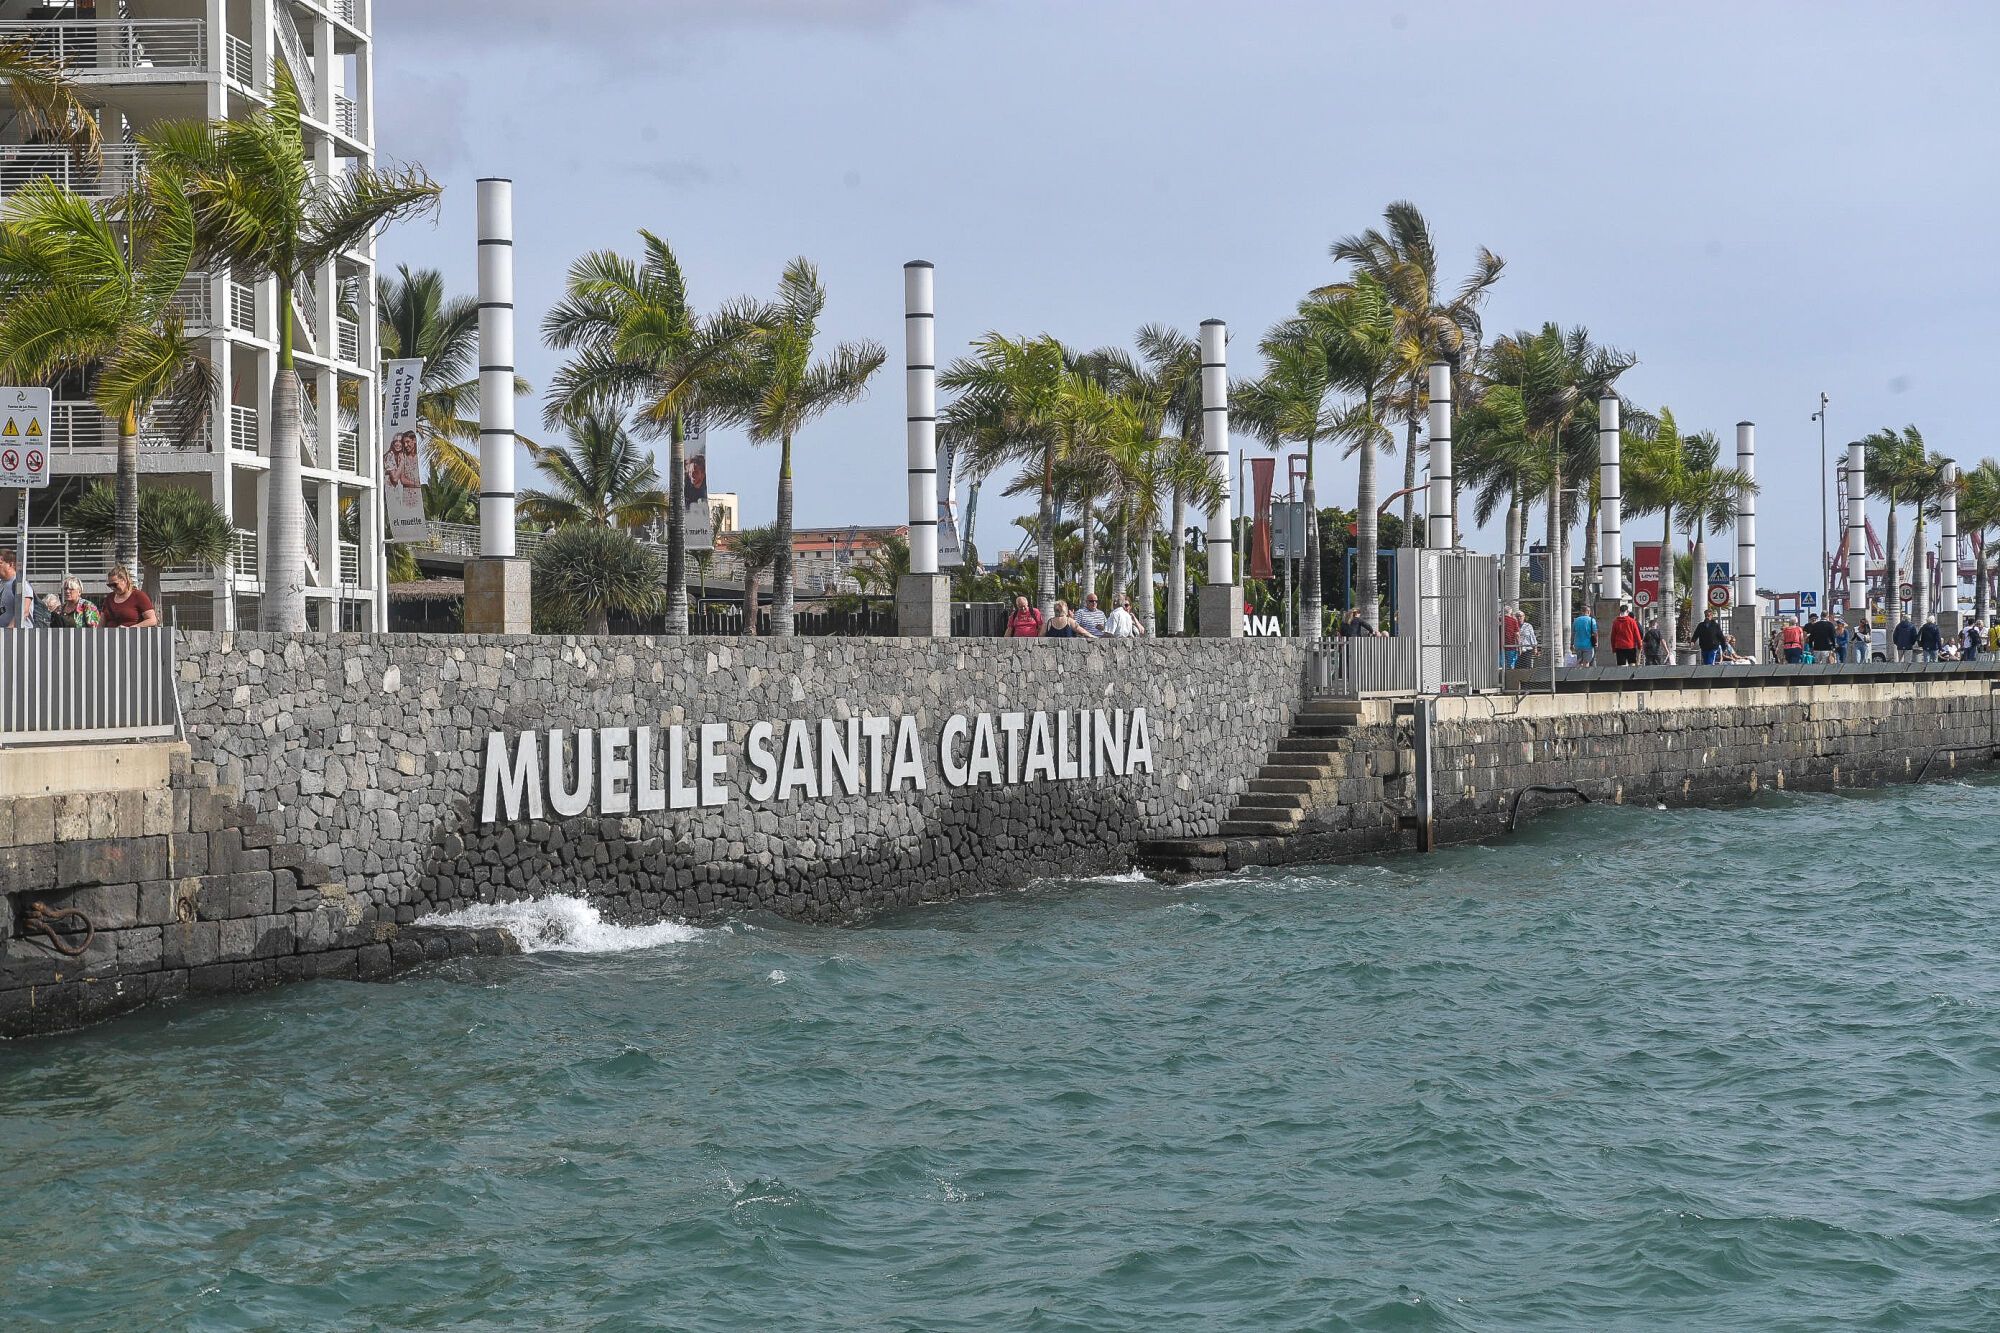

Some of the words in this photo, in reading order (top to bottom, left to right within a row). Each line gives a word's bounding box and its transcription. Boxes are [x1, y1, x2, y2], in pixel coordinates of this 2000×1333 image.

[396, 366, 404, 375] &
[391, 379, 402, 427] Fashion
[401, 374, 414, 417] Beauty
[1712, 592, 1725, 600] 20
[482, 723, 729, 824] MUELLE
[748, 714, 927, 802] SANTA
[941, 707, 1154, 787] CATALINA
